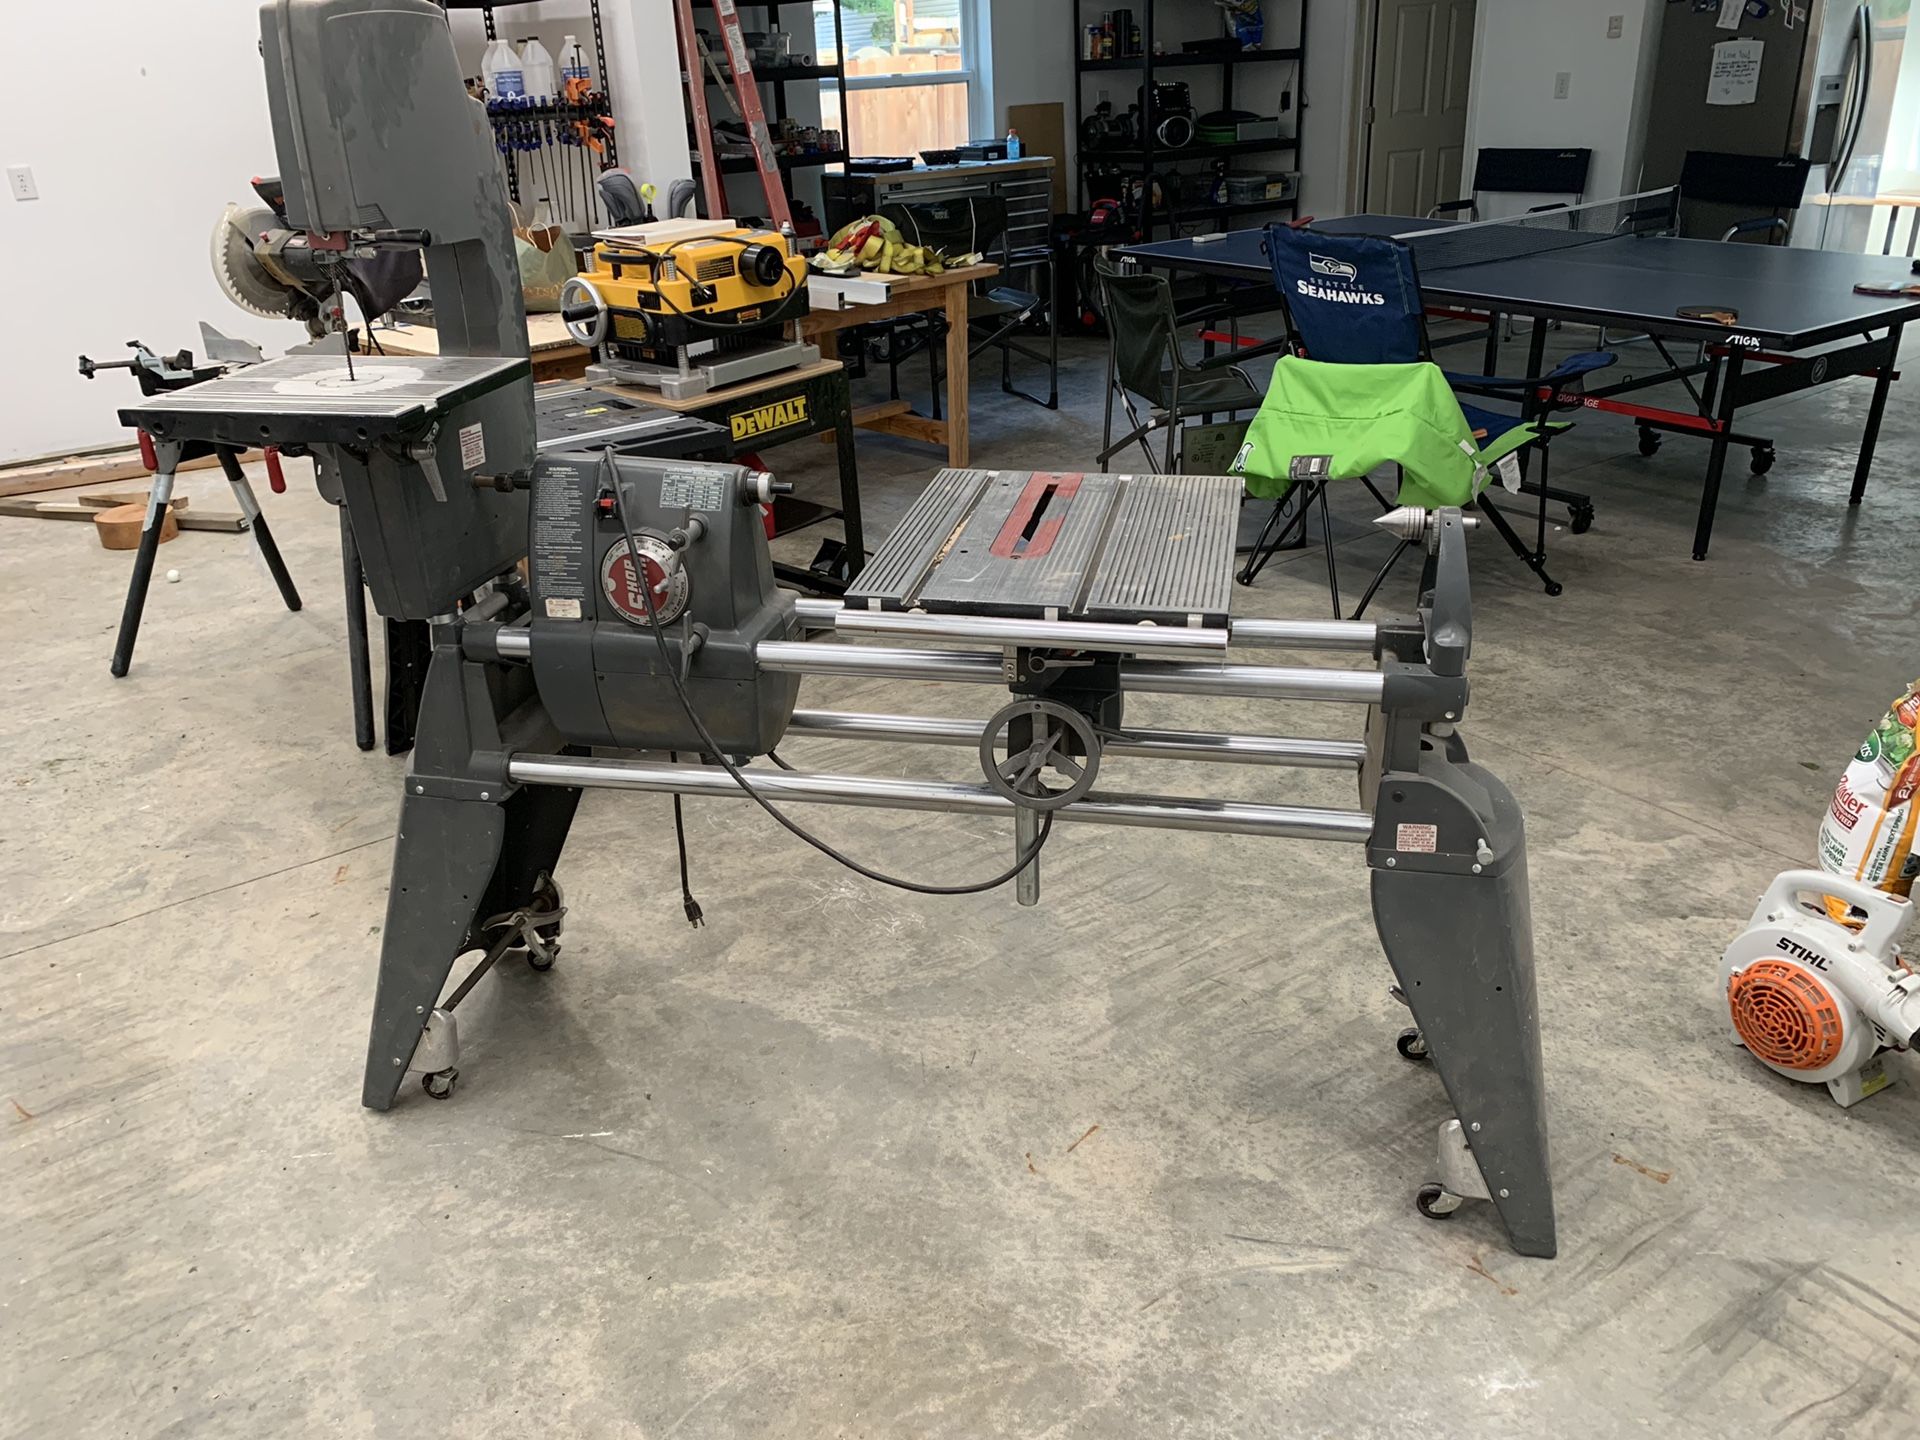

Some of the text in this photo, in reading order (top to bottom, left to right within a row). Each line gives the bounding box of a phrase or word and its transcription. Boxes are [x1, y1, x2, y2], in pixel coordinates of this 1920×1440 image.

[1297, 279, 1385, 305] SEAHAWKS
[1310, 277, 1364, 291] SEATTLE
[1725, 334, 1760, 348] STIGA
[1872, 862, 1884, 882] BETTER
[1880, 845, 1891, 861] LAWN
[1886, 828, 1897, 845] NEXT
[1776, 937, 1828, 972] STIHL
